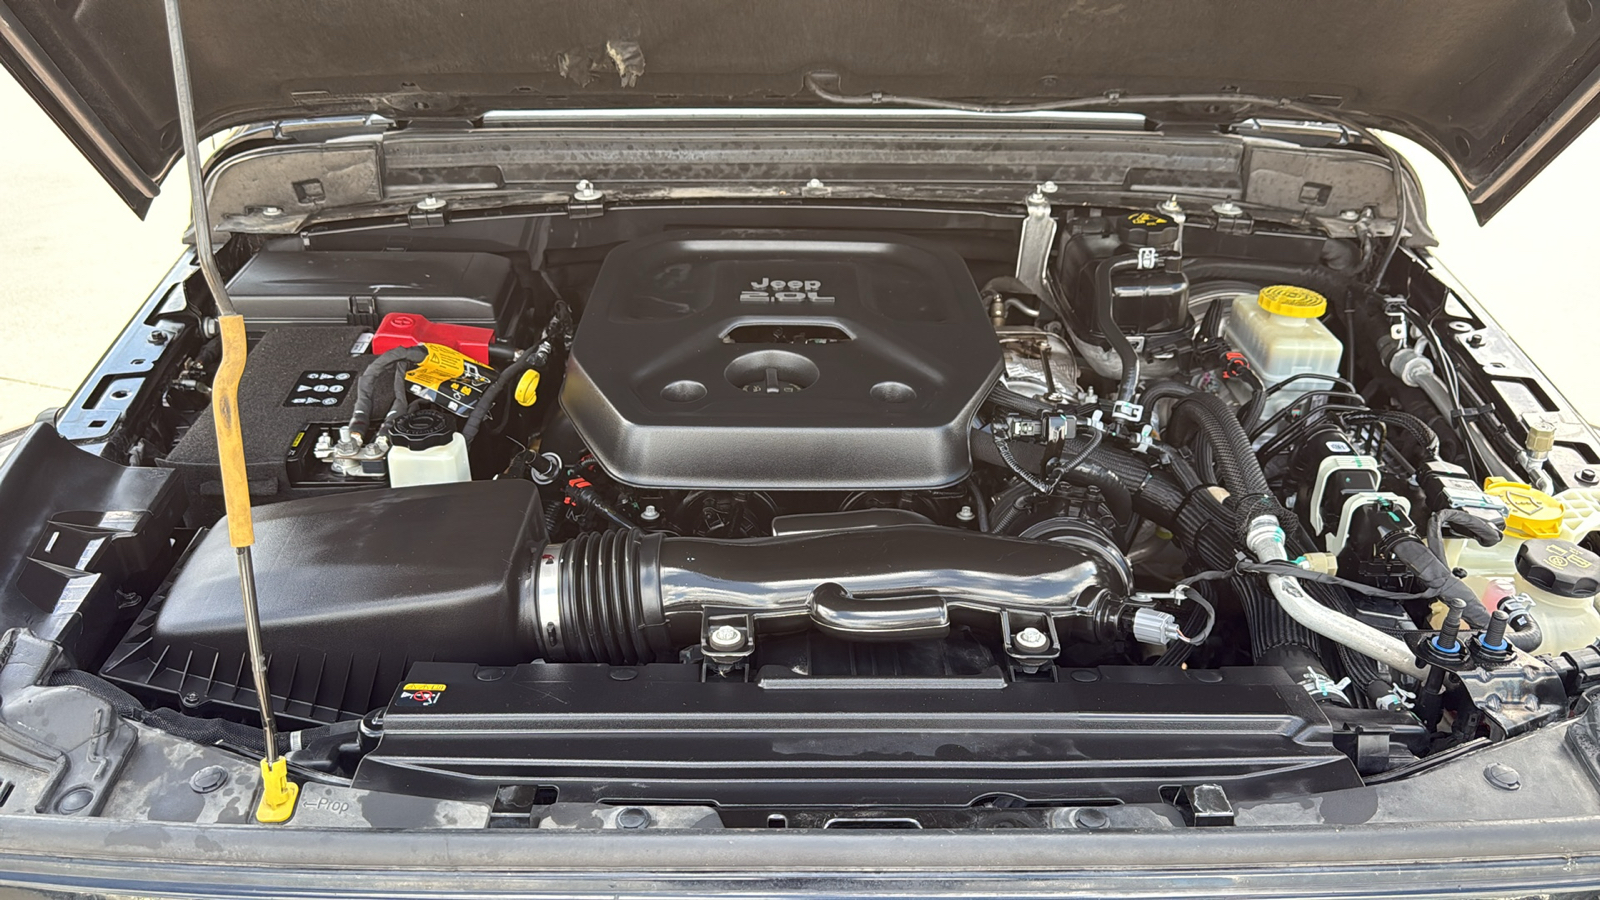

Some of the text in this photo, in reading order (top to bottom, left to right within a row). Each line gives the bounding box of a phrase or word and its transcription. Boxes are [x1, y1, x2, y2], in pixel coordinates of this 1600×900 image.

[751, 278, 821, 291] Jeep
[740, 291, 835, 302] 2.0L
[317, 797, 349, 814] Prop
